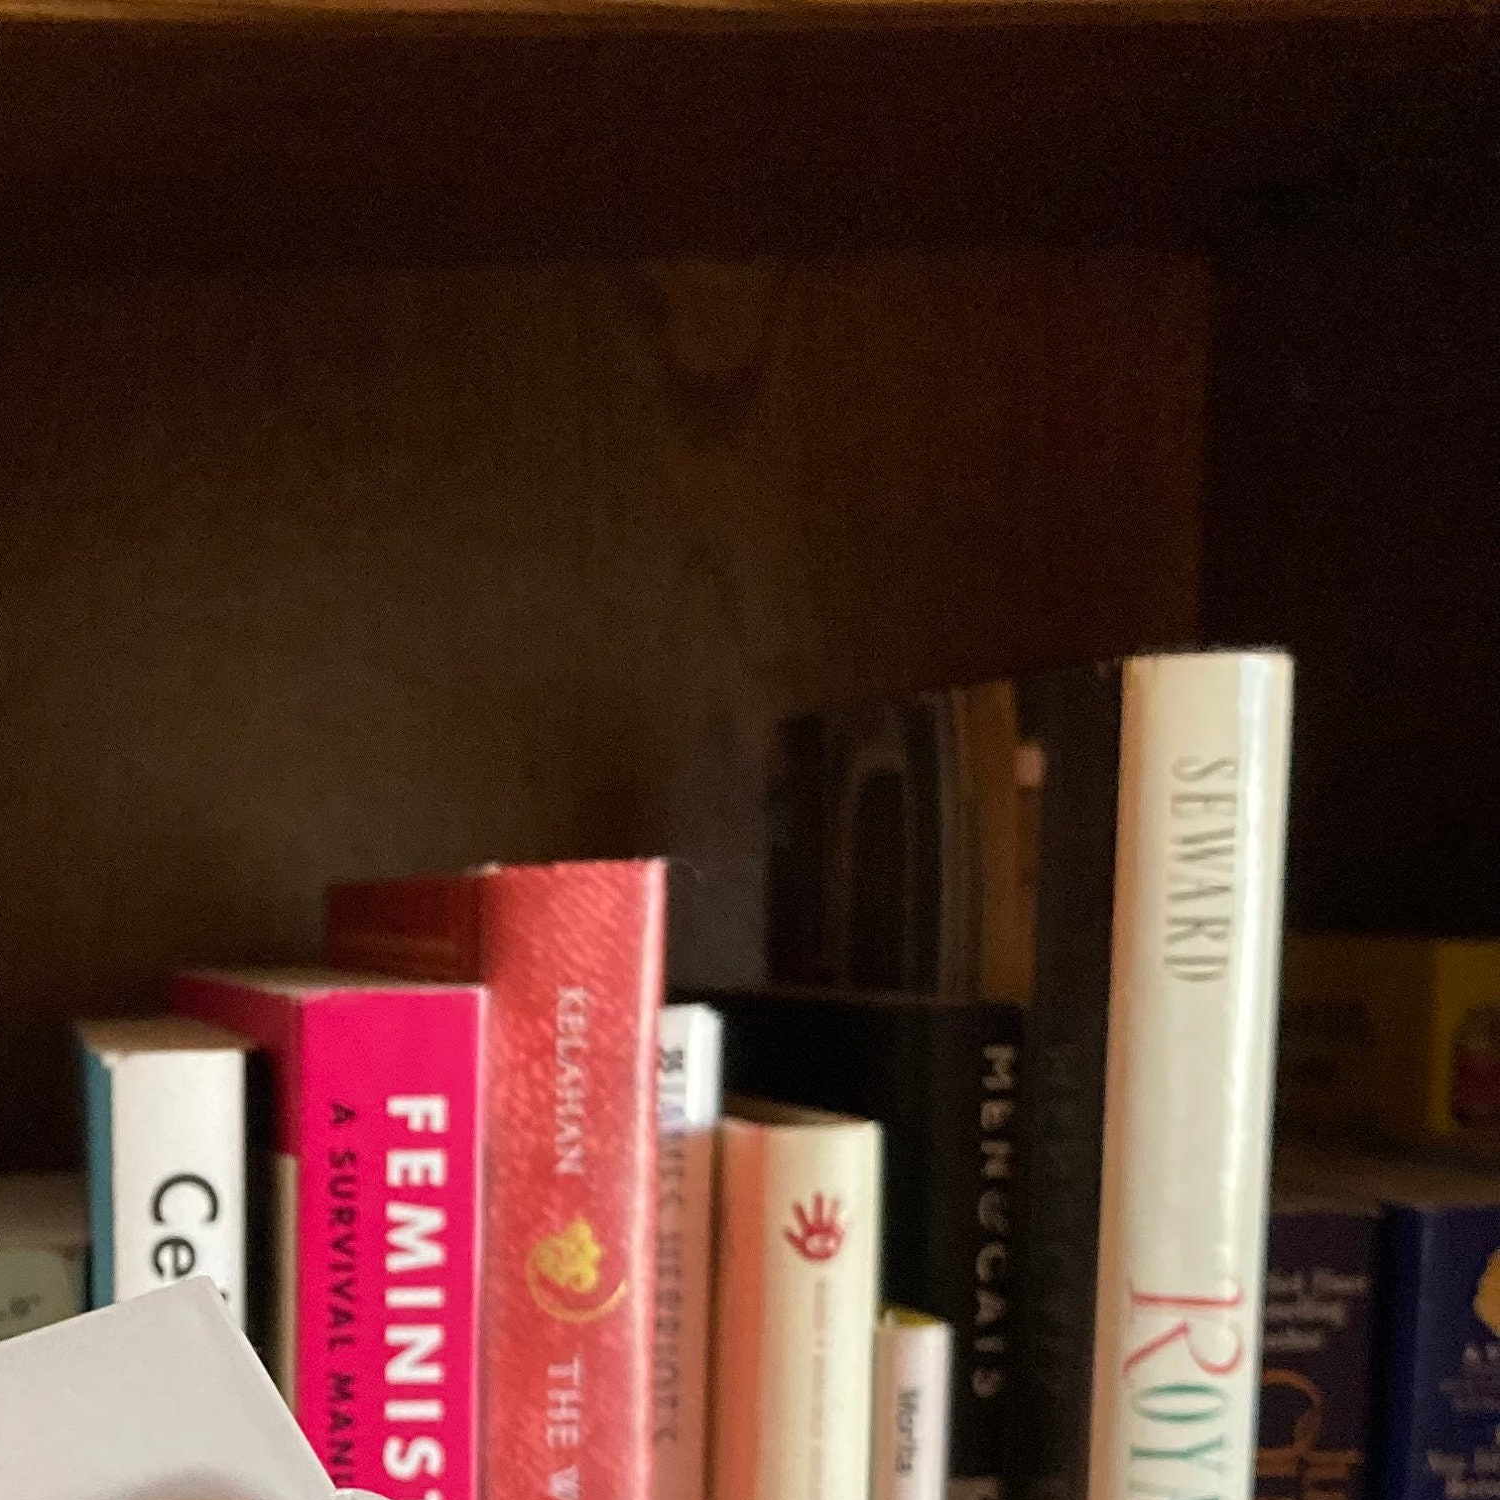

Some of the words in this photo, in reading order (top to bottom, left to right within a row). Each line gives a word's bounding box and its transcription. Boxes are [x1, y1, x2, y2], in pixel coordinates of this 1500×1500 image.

[1164, 755, 1238, 982] SEWARD
[331, 1102, 358, 1128] A
[554, 985, 590, 1177] KELAHAN
[152, 1172, 222, 1282] Ce
[326, 1150, 361, 1353] SURVIVAL
[544, 1357, 584, 1448] THE
